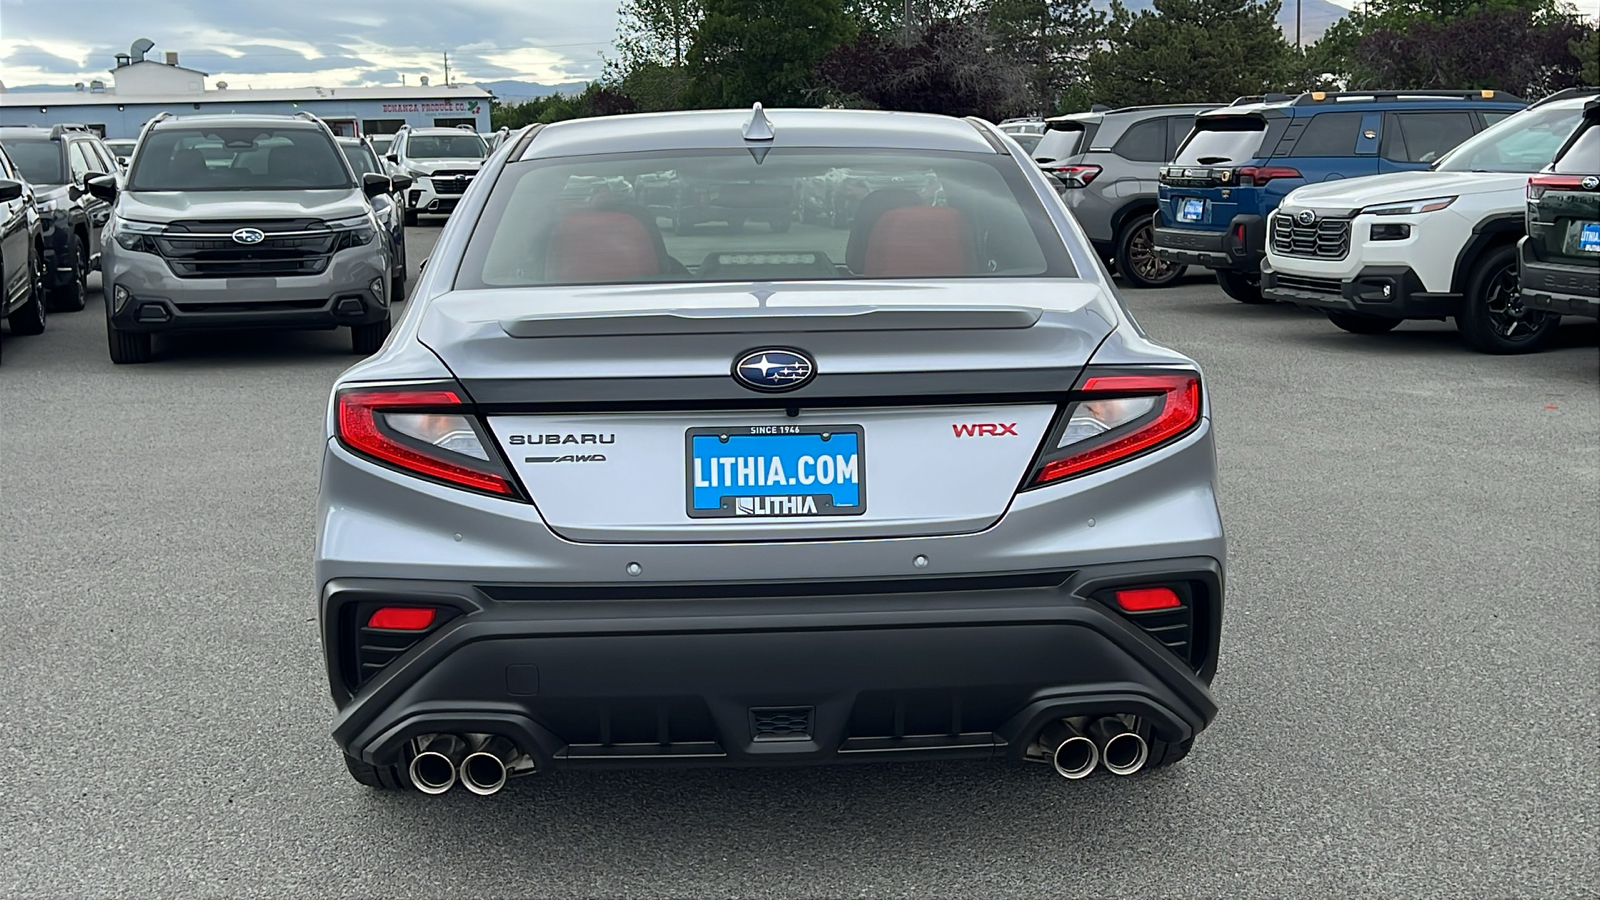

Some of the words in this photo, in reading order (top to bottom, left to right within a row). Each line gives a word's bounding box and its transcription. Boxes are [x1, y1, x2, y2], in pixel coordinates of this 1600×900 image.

[383, 104, 419, 113] BONANZA
[421, 103, 453, 112] PRODUCE
[455, 103, 466, 111] CO.
[750, 426, 777, 434] SINCE
[779, 426, 800, 434] 1946
[952, 422, 1018, 437] WRX
[508, 433, 615, 445] SUBARU
[555, 454, 607, 463] AWD
[694, 454, 859, 488] LITHIA.COM
[755, 496, 818, 514] LITHIA
